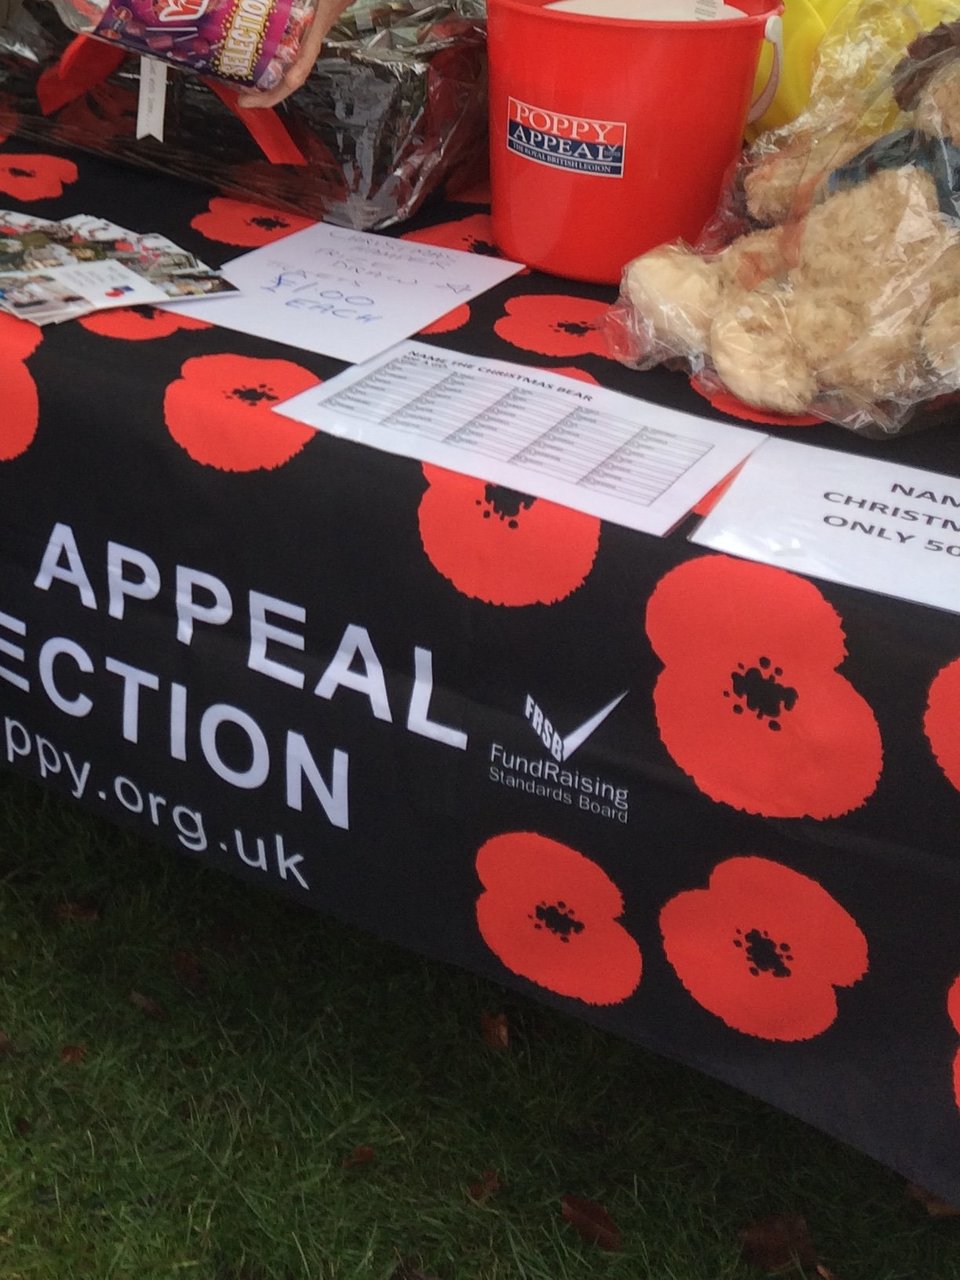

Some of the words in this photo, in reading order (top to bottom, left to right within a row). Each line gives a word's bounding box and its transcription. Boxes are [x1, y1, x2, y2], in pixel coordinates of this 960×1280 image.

[513, 125, 613, 162] APPEAL
[515, 103, 614, 143] POPPY
[513, 141, 523, 152] THE
[524, 147, 546, 161] ROYAL
[547, 156, 579, 169] BRITISH
[580, 163, 611, 173] LEGION
[285, 298, 383, 323] EACH
[408, 350, 447, 364] NAME
[451, 360, 475, 369] THE
[477, 367, 554, 390] CHRISTMAS
[556, 386, 594, 402] BEAR
[823, 515, 916, 544] ONLY
[33, 522, 469, 751] APPEAL
[525, 693, 564, 762] FRSB
[490, 766, 572, 805] Standards
[579, 795, 628, 824] Board
[491, 743, 629, 810] FundRaising
